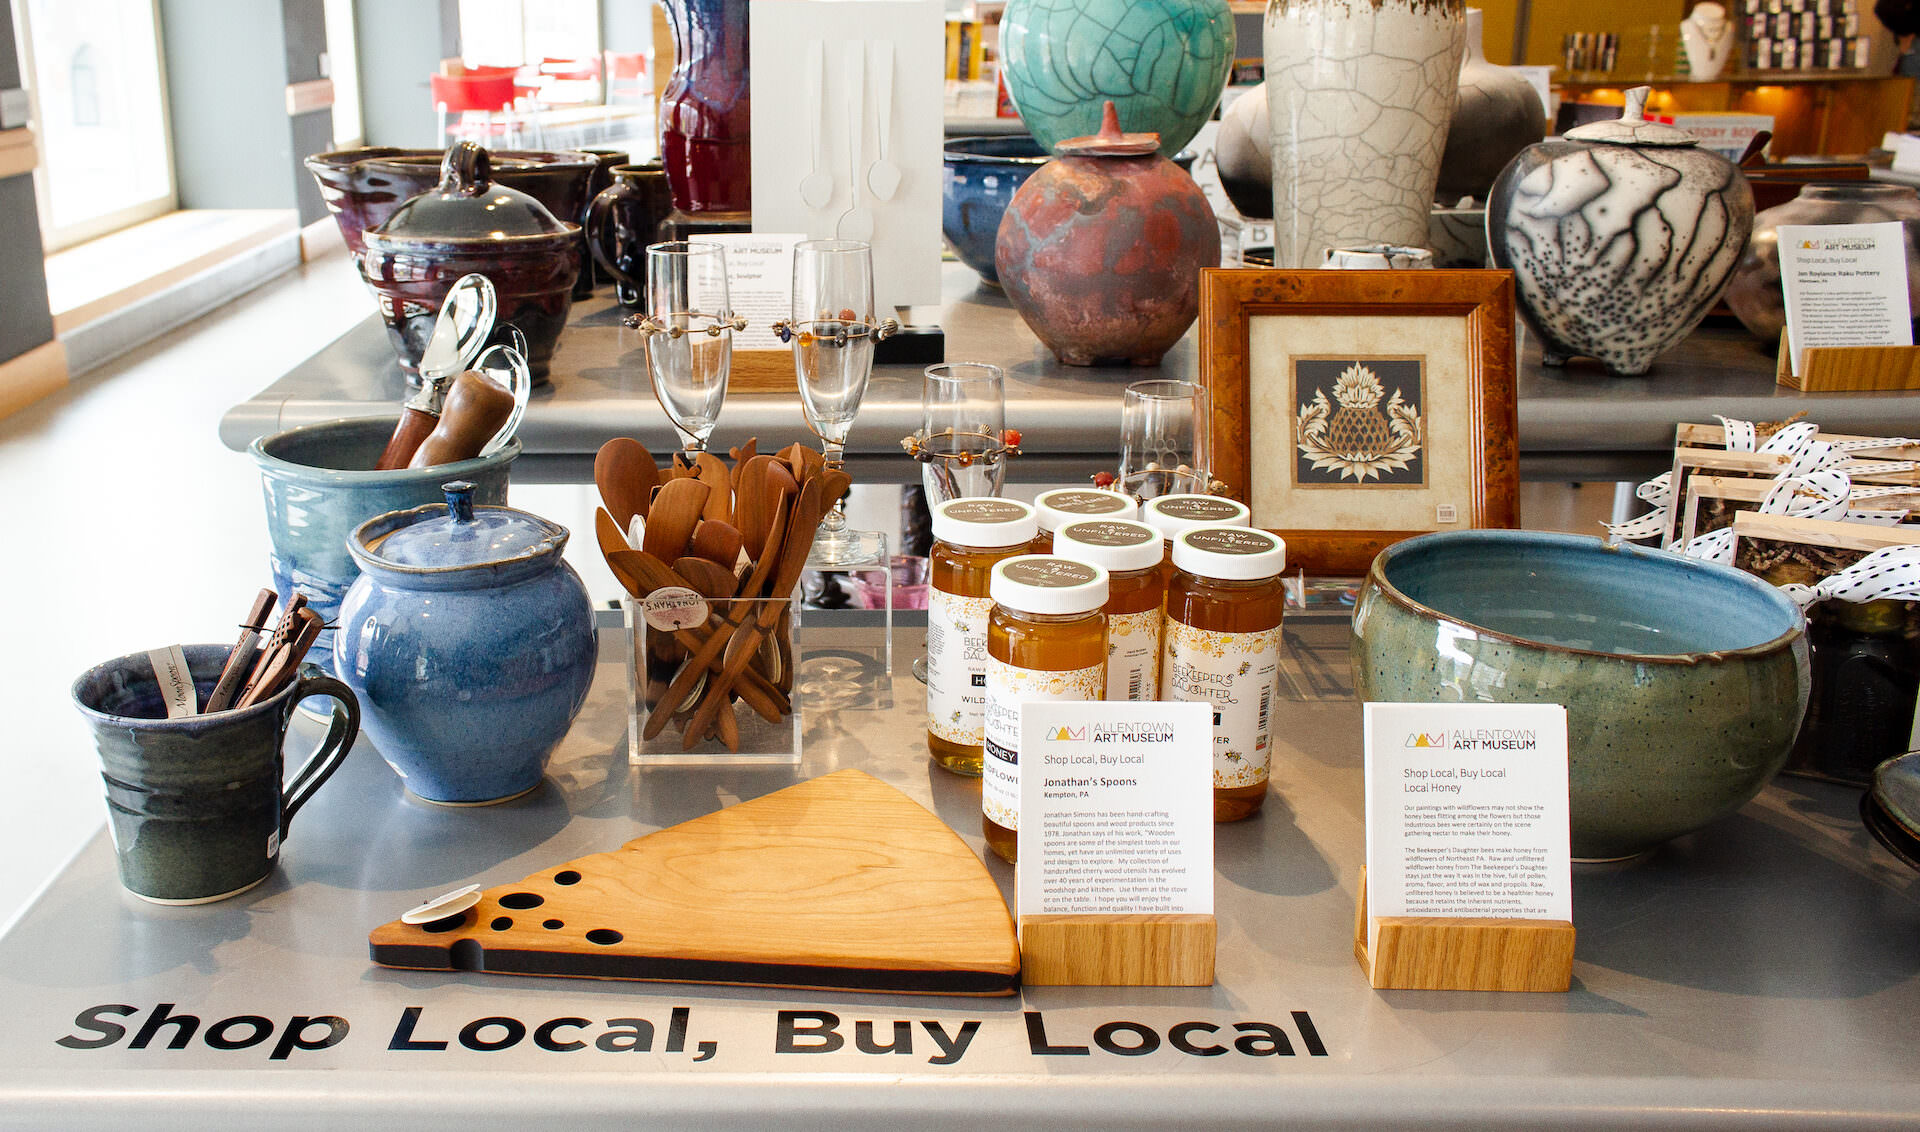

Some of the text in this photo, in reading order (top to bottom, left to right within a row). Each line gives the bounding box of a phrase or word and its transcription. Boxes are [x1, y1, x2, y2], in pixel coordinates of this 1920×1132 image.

[1073, 528, 1146, 538] UNFILTERED
[1193, 535, 1268, 547] UNFILTERED
[1046, 562, 1076, 570] RAW
[1016, 564, 1088, 580] UNFILTERED
[1172, 676, 1238, 704] DAUGHTER
[1094, 722, 1174, 733] ALLENTOWN
[1094, 733, 1174, 742] ART MUSEUM
[1453, 730, 1536, 740] ALLENTOWN
[1453, 740, 1536, 750] ART MUSEUM
[1044, 754, 1144, 766] Shop Local, Buy Local
[1404, 768, 1506, 780] Shop Local, Buy Local
[1044, 777, 1137, 788] Jonathan's Spoons
[1404, 783, 1462, 794] Local Honey
[1044, 791, 1078, 800] Kempton,
[1416, 804, 1442, 812] paintings
[1405, 813, 1422, 821] honey
[1467, 821, 1492, 829] certainly
[1405, 830, 1432, 838] gathering
[1492, 830, 1512, 838] honey.
[1083, 868, 1103, 876] cherry
[55, 1004, 1329, 1064] Shop Local, Buy Local
